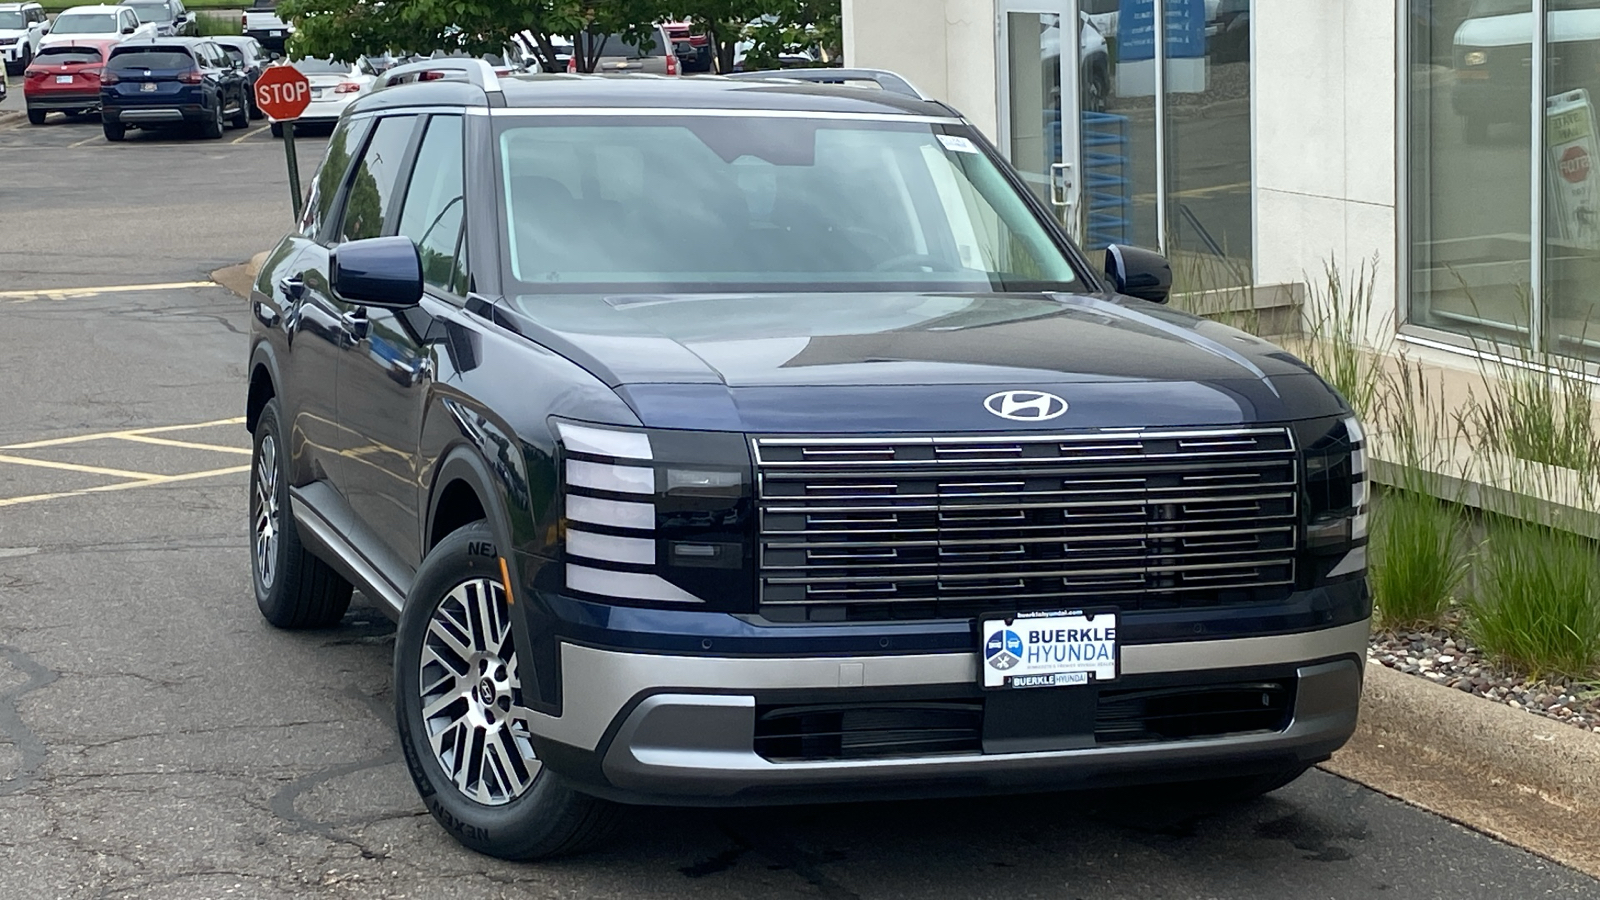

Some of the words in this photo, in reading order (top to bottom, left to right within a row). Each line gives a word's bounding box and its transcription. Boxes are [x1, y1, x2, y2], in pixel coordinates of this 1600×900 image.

[259, 81, 308, 105] STOP
[1029, 628, 1115, 644] BUERKLE
[1028, 643, 1115, 663] HYUNDAI
[1014, 675, 1055, 686] BUERKLE
[1055, 673, 1086, 684] HYUNDAI
[432, 799, 491, 840] NEXEN
